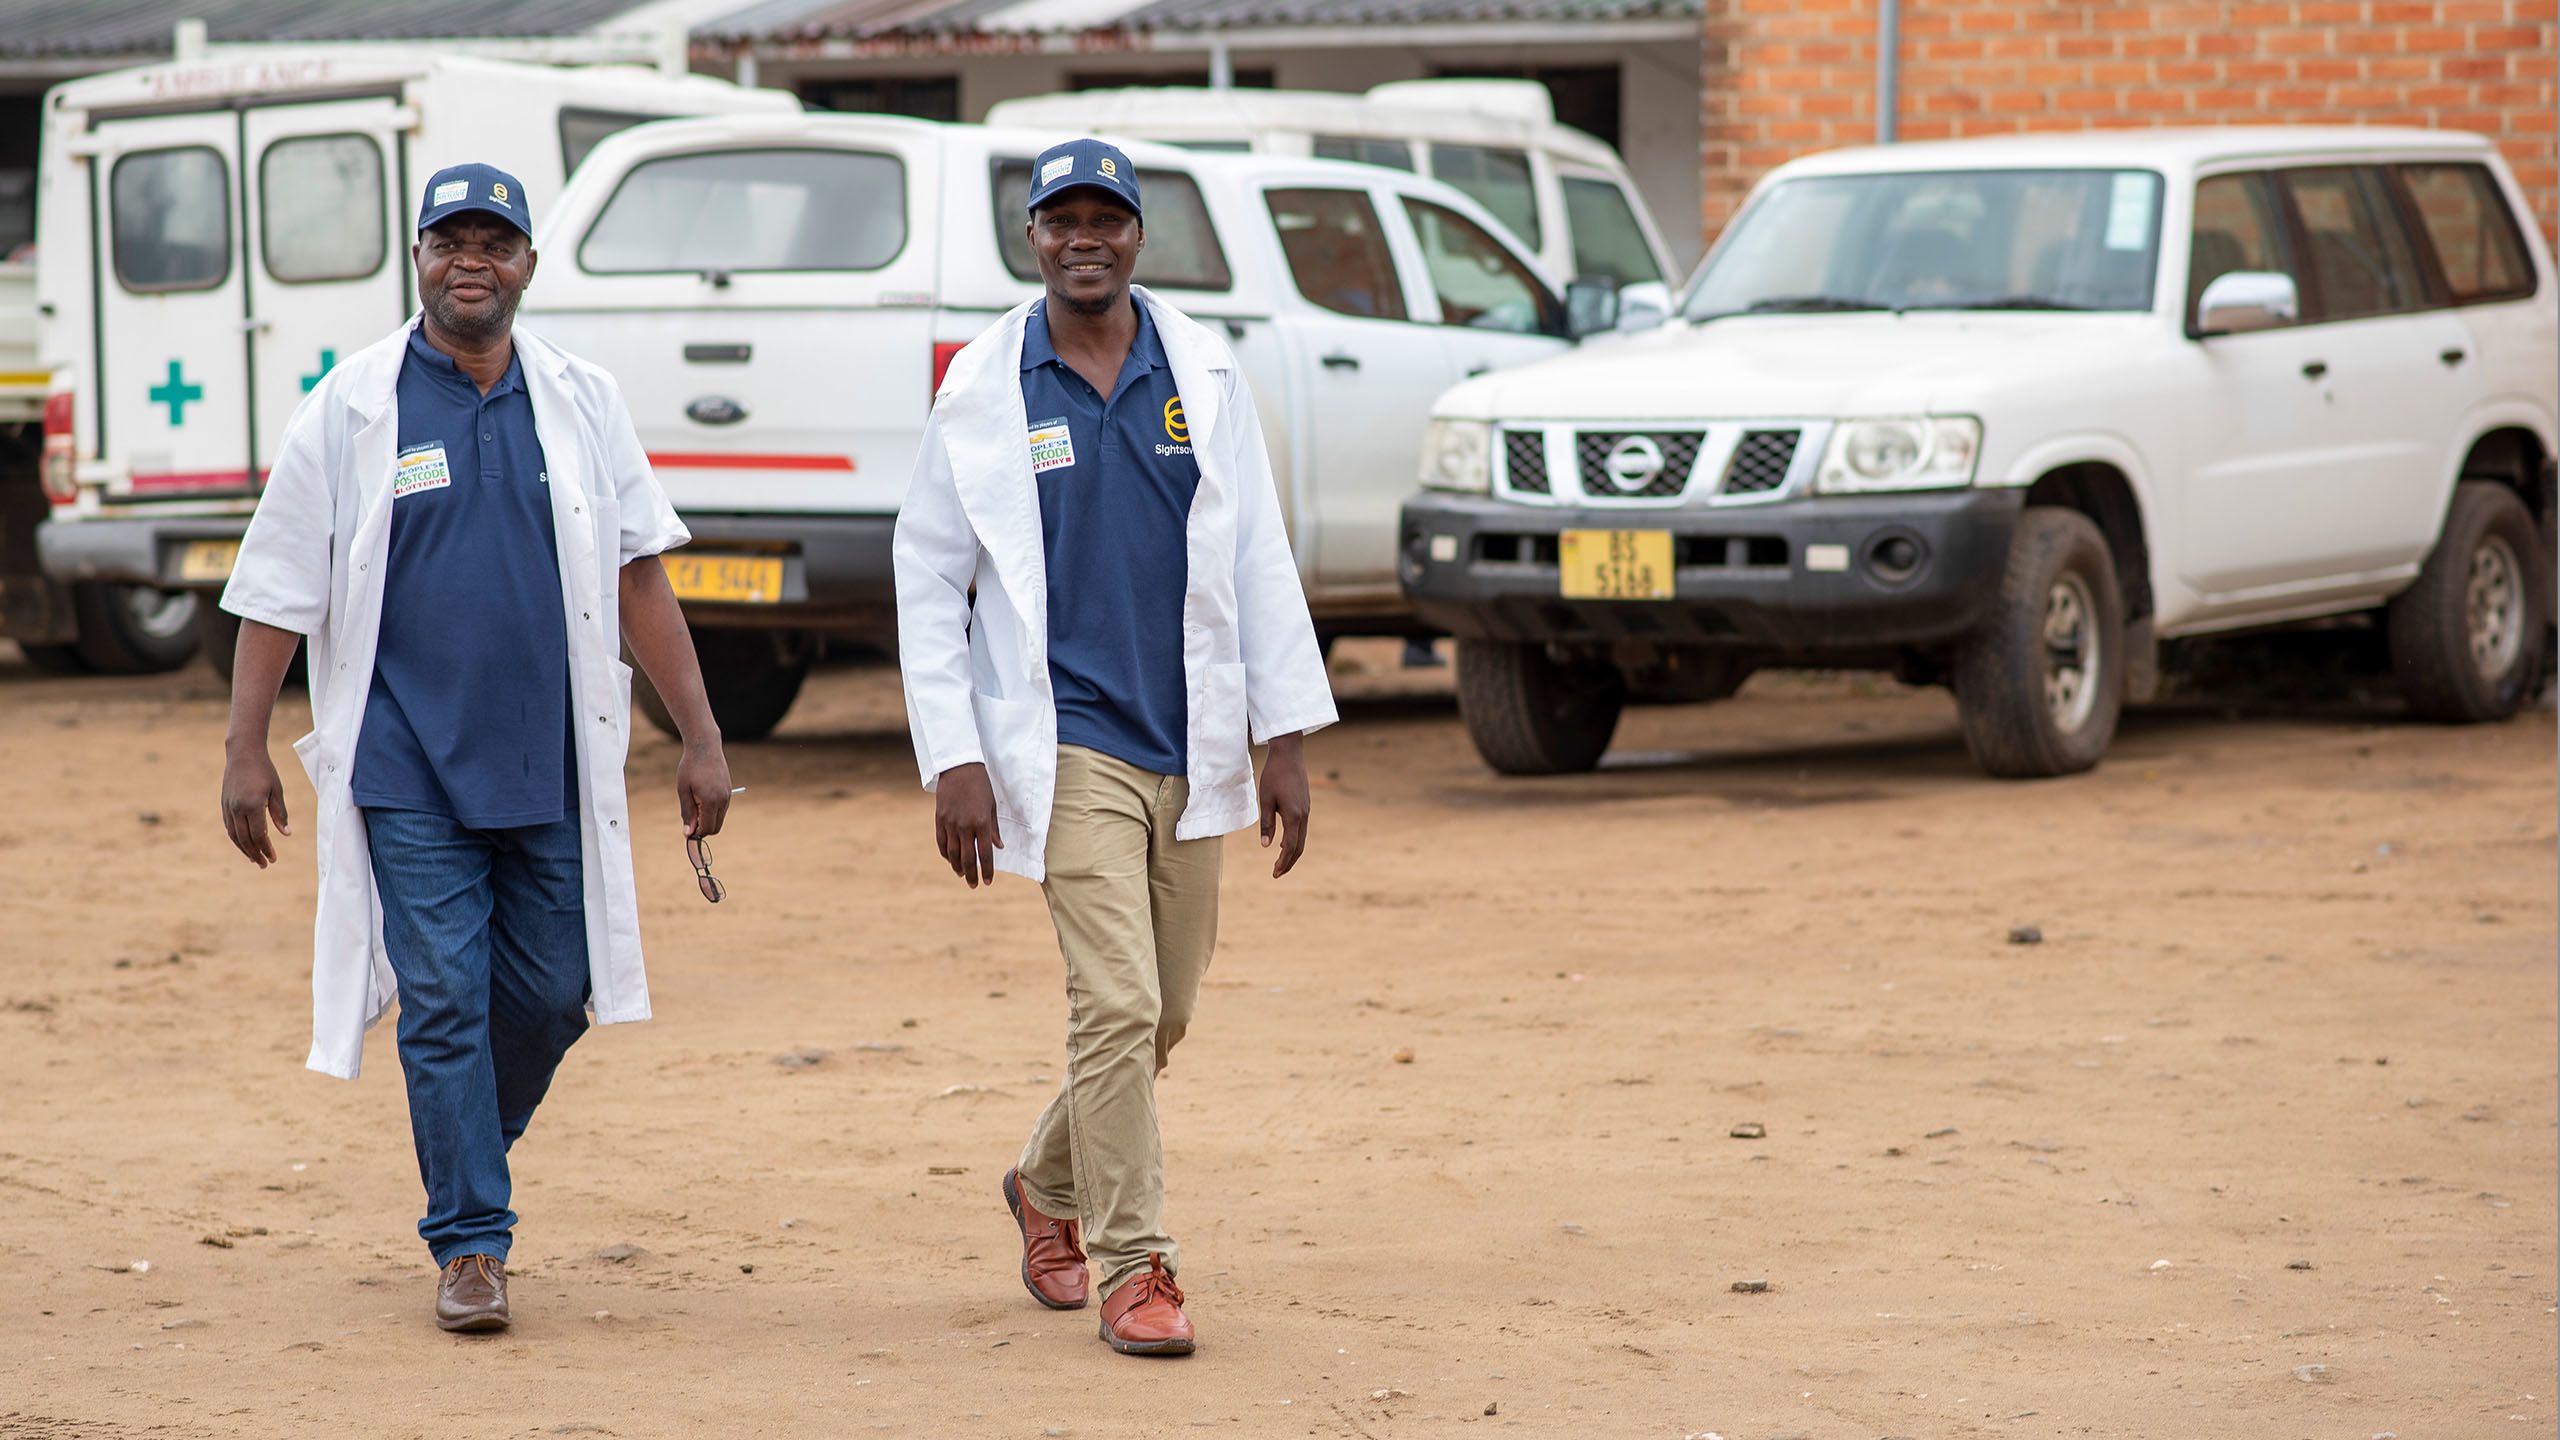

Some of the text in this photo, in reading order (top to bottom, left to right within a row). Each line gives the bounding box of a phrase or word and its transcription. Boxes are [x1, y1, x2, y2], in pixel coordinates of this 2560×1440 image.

[1030, 440, 1062, 453] OPLE'S
[1155, 443, 1193, 456] Sightsav
[1031, 446, 1070, 464] STCODE
[397, 462, 438, 478] PEOPLE'S
[394, 467, 446, 489] POSTCODE
[400, 478, 441, 493] LOTTERY
